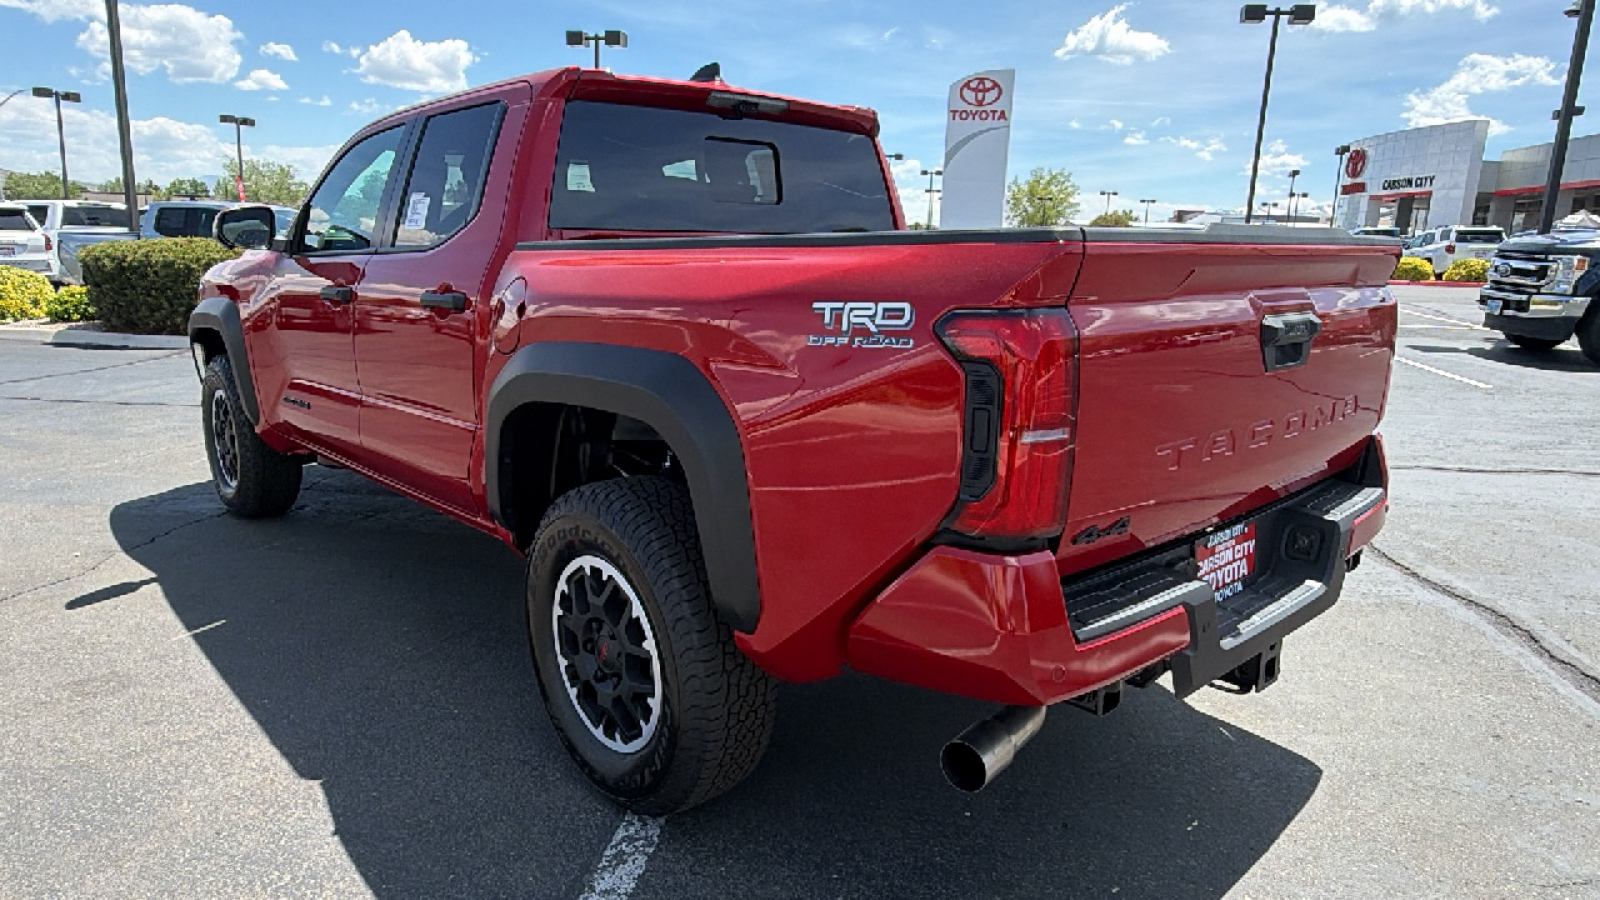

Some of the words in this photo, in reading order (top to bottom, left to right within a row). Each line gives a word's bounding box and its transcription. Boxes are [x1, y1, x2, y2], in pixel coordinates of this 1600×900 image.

[950, 109, 1008, 121] TOYOTA
[1382, 179, 1413, 190] CARSON
[1414, 175, 1435, 188] CITY
[812, 301, 916, 336] TRD
[807, 335, 849, 347] OFF
[852, 334, 914, 348] ROAD
[1156, 395, 1358, 471] TACOMA
[1232, 523, 1245, 537] CITY
[1197, 547, 1233, 577] CARSON
[1234, 539, 1256, 560] CITY
[1214, 580, 1244, 604] TOYOTA
